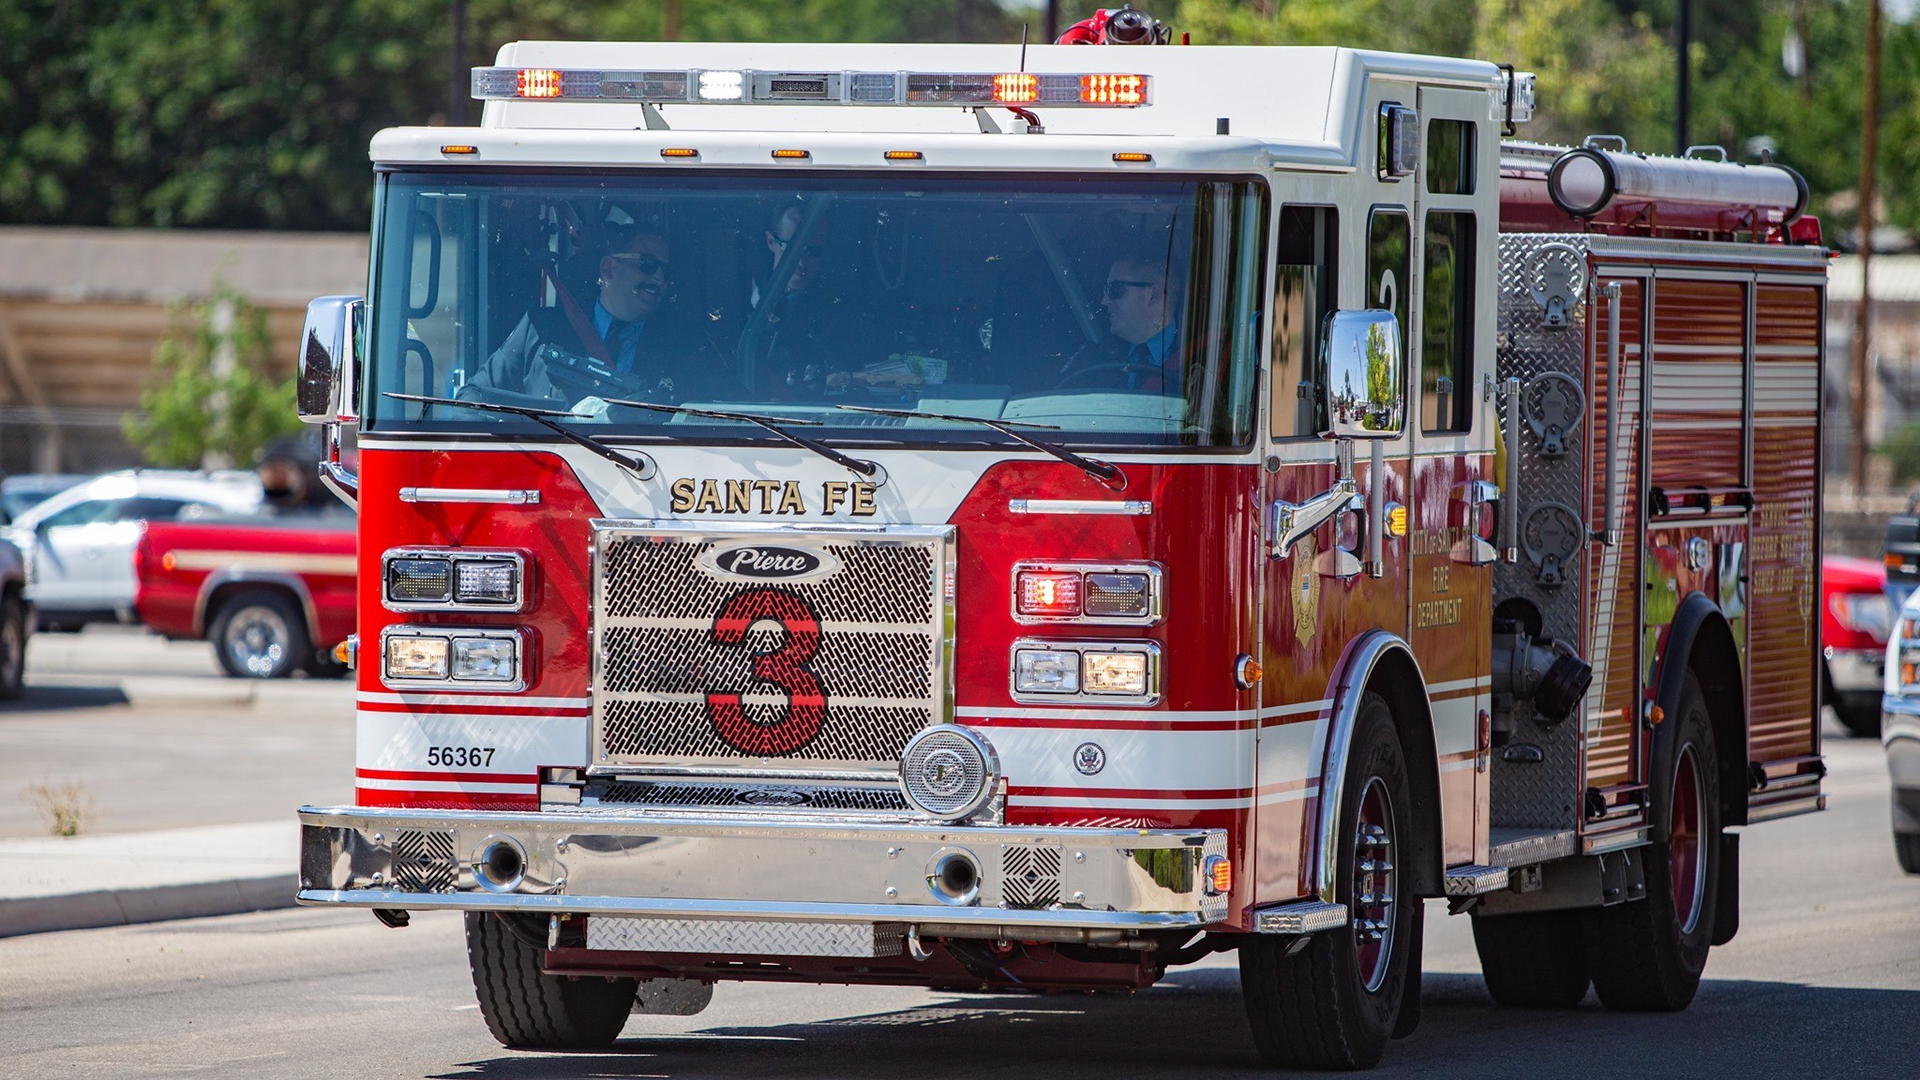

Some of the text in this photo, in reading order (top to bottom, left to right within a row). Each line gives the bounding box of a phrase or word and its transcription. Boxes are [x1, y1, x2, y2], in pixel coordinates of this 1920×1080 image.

[670, 477, 878, 516] SANTA FE
[1412, 528, 1428, 557] CITY
[730, 548, 807, 573] Pierce
[1432, 565, 1449, 593] FIRE
[1417, 598, 1462, 629] DEPARTMENT
[704, 586, 829, 758] 3
[427, 746, 496, 767] 56367
